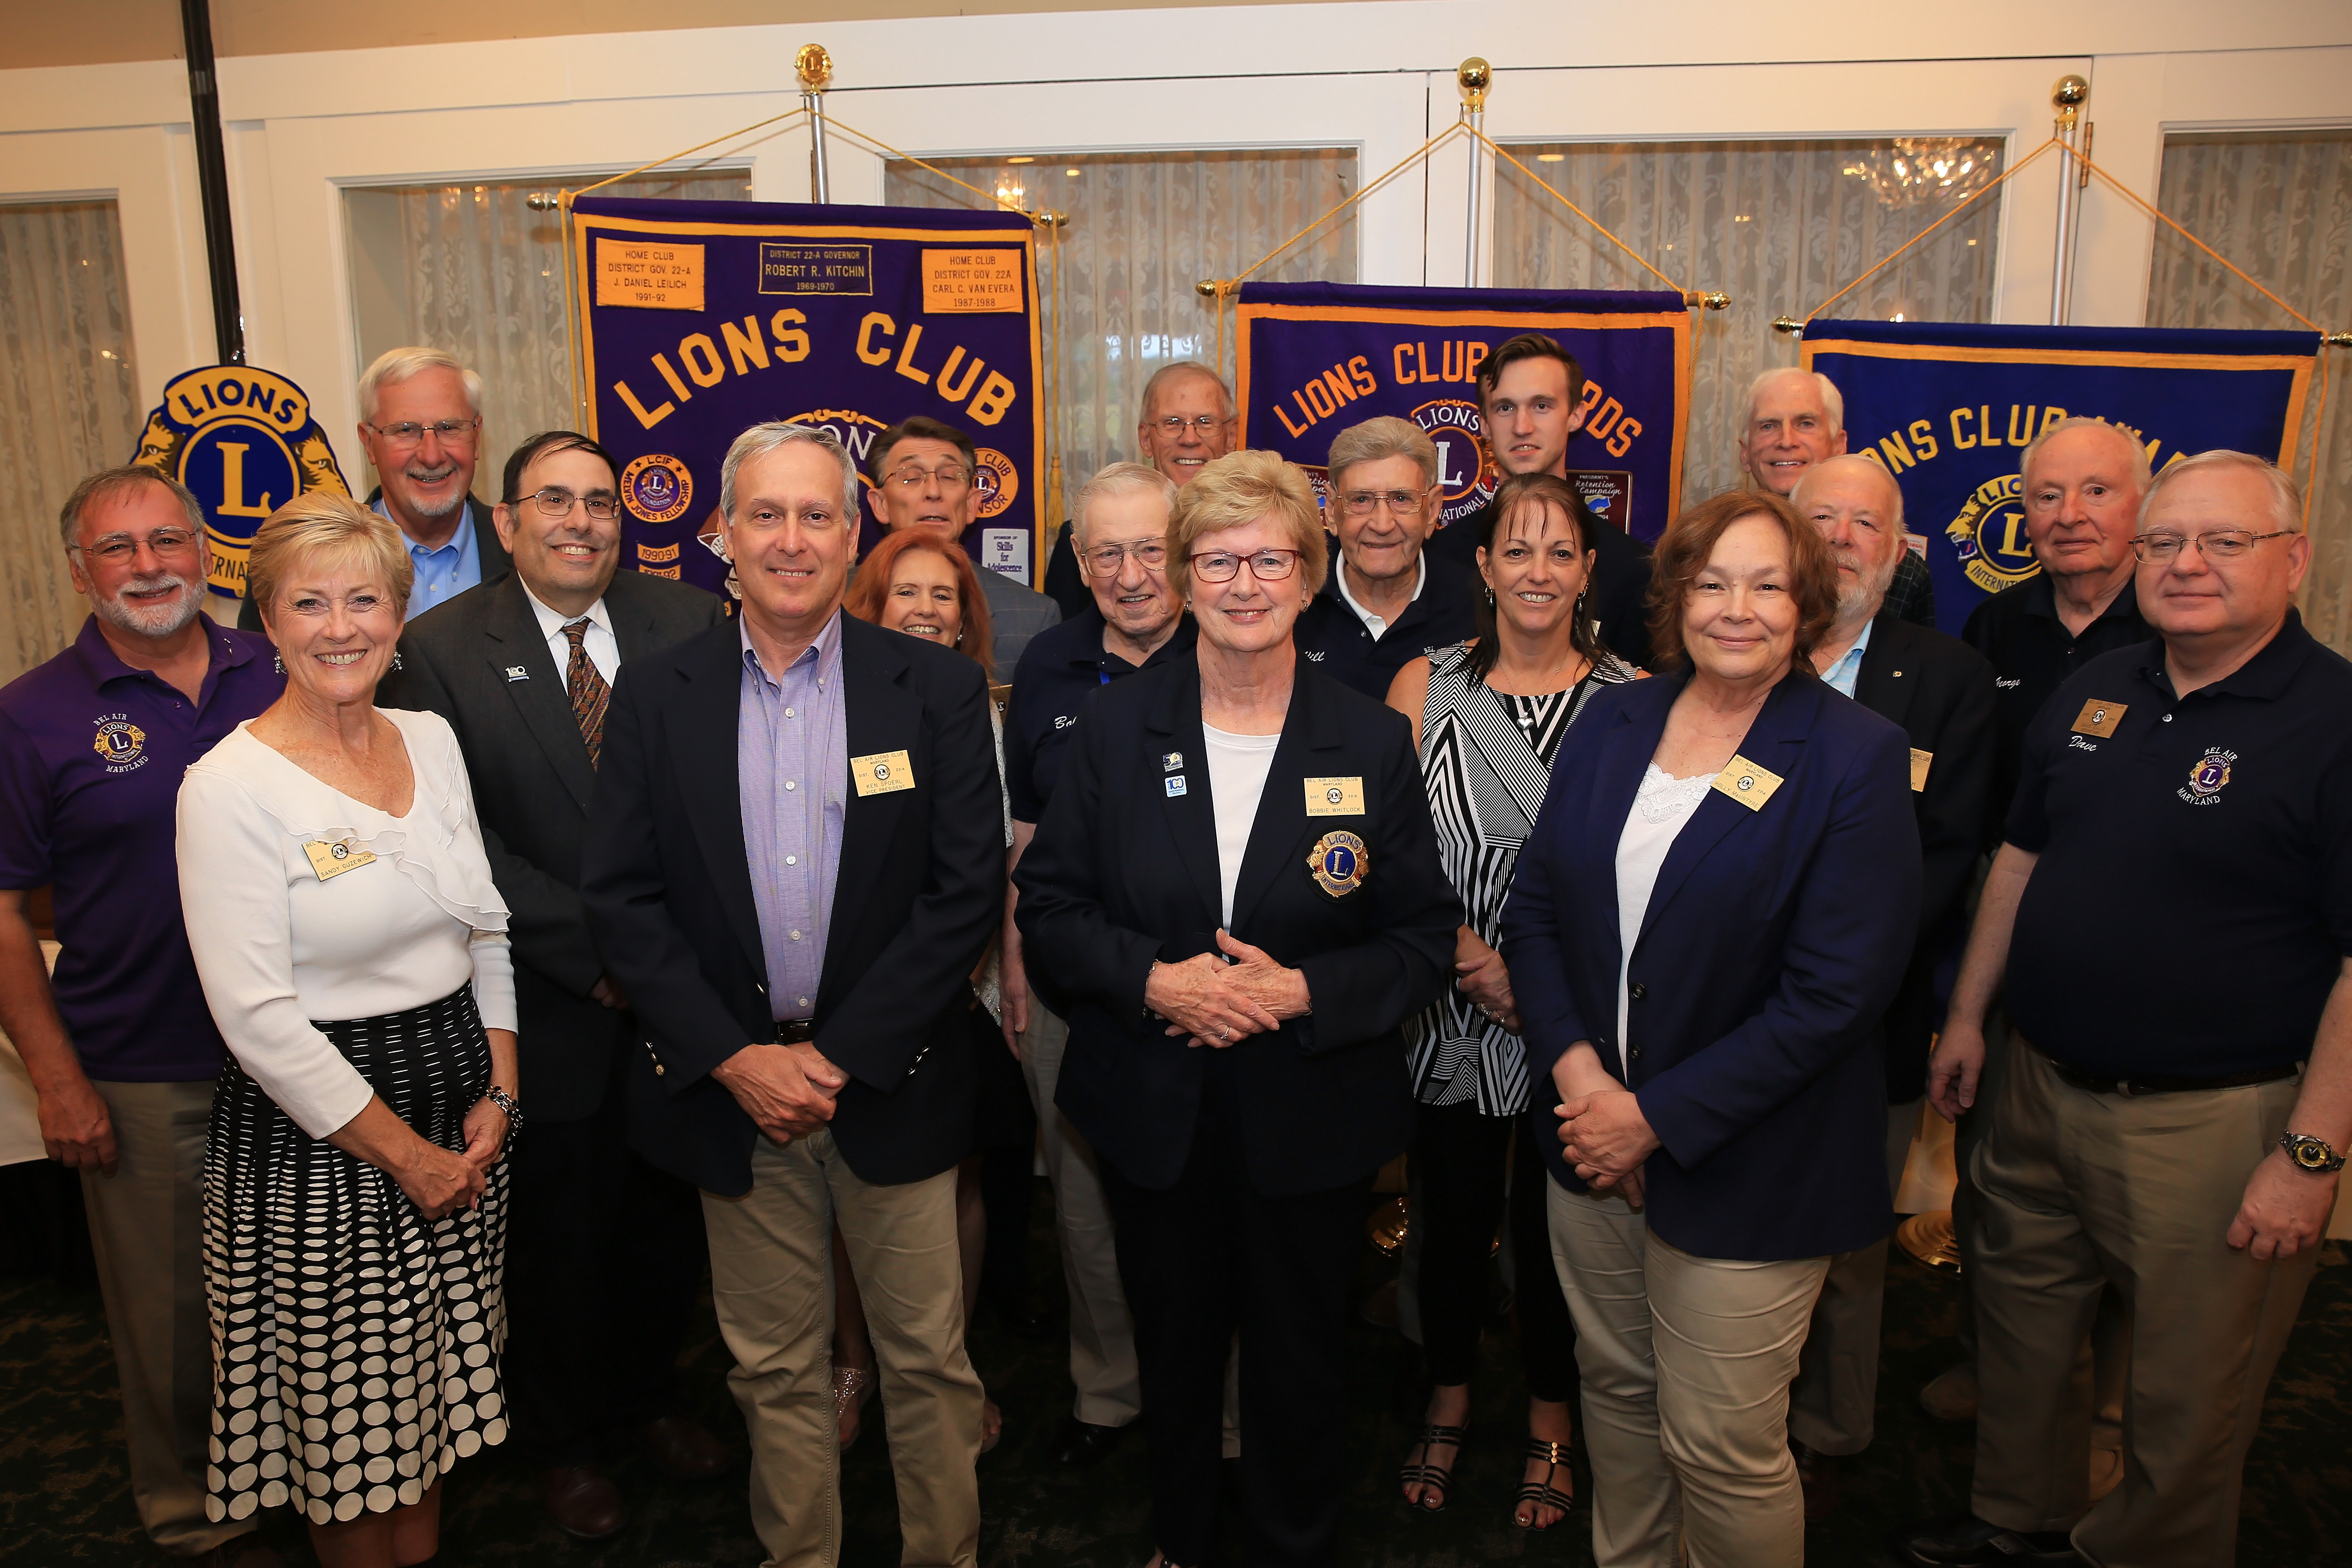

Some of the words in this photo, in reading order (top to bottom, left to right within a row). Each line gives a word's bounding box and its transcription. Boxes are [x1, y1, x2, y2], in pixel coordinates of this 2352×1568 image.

[626, 250, 648, 259] HOME
[653, 252, 674, 260] CLUB
[770, 250, 801, 259] DISTRICT
[804, 251, 821, 259] 22-A
[824, 251, 860, 259] GOVERNOR
[950, 256, 972, 265] HOME
[976, 256, 996, 265] CLUB
[608, 263, 645, 273] DISTRICT
[650, 265, 668, 274] GOV.
[672, 267, 690, 275] 22-A
[765, 264, 806, 277] ROBERT
[811, 265, 821, 277] R.
[826, 265, 865, 277] KITCHIN
[934, 270, 970, 279] DISTRICT
[974, 270, 992, 279] GOV.
[996, 270, 1011, 279] 22A
[614, 278, 619, 286] J.
[624, 278, 652, 287] DANIEL
[657, 280, 686, 288] LEILICH
[796, 282, 835, 291] 1969-1970
[933, 284, 954, 293] CARL
[958, 284, 965, 293] C.
[969, 284, 985, 293] VAN
[988, 284, 1015, 293] EVERA
[636, 293, 666, 301] 1991-92
[954, 298, 996, 307] 1987-1988
[613, 307, 811, 430] LIONS
[855, 311, 1016, 426] CLUB
[1273, 355, 1377, 439] LIONS
[1393, 340, 1489, 385] CLUB
[178, 379, 299, 425] LIONS
[1415, 406, 1480, 431] LIONS
[647, 455, 673, 465] LCIF
[984, 453, 1011, 477] CLUB
[1436, 441, 1463, 486] L
[216, 441, 274, 518] L
[652, 476, 662, 490] L
[978, 477, 987, 490] L
[1575, 480, 1616, 488] Retention
[624, 471, 634, 503] MELVIN
[631, 504, 657, 521] JONES
[660, 479, 689, 520] FELLOWSHIP
[1579, 487, 1622, 498] Campaign
[1982, 477, 2021, 502] LIO
[640, 494, 672, 506] FOUNDATION
[978, 494, 1008, 514] NSOR
[1439, 496, 1485, 520] NATIONAL
[1998, 512, 2033, 558] L
[997, 541, 1013, 551] Skills
[642, 548, 677, 561] 1990-91
[1000, 552, 1009, 562] for
[93, 715, 110, 726] BEL
[102, 724, 129, 735] LIONS
[112, 733, 129, 750] L
[2068, 735, 2097, 752] Dave
[2204, 746, 2221, 755] BEL
[2222, 749, 2238, 762] AIR
[106, 755, 149, 773] MARYLAND
[2207, 757, 2228, 768] LIONS
[1746, 768, 1764, 779] MARYLAND
[1753, 766, 1767, 776] LIONS
[1768, 774, 1780, 783] CLUB
[2202, 768, 2216, 785] L
[879, 784, 905, 792] PRESIDENT
[1714, 781, 1731, 792] HOLLY
[1731, 791, 1760, 808] MacINTYRE
[2176, 786, 2221, 805] MARYLAND
[1327, 834, 1361, 849] LIONS
[321, 866, 340, 877] SANDY
[342, 854, 372, 869] GUZEWICH
[1330, 850, 1349, 877] L
